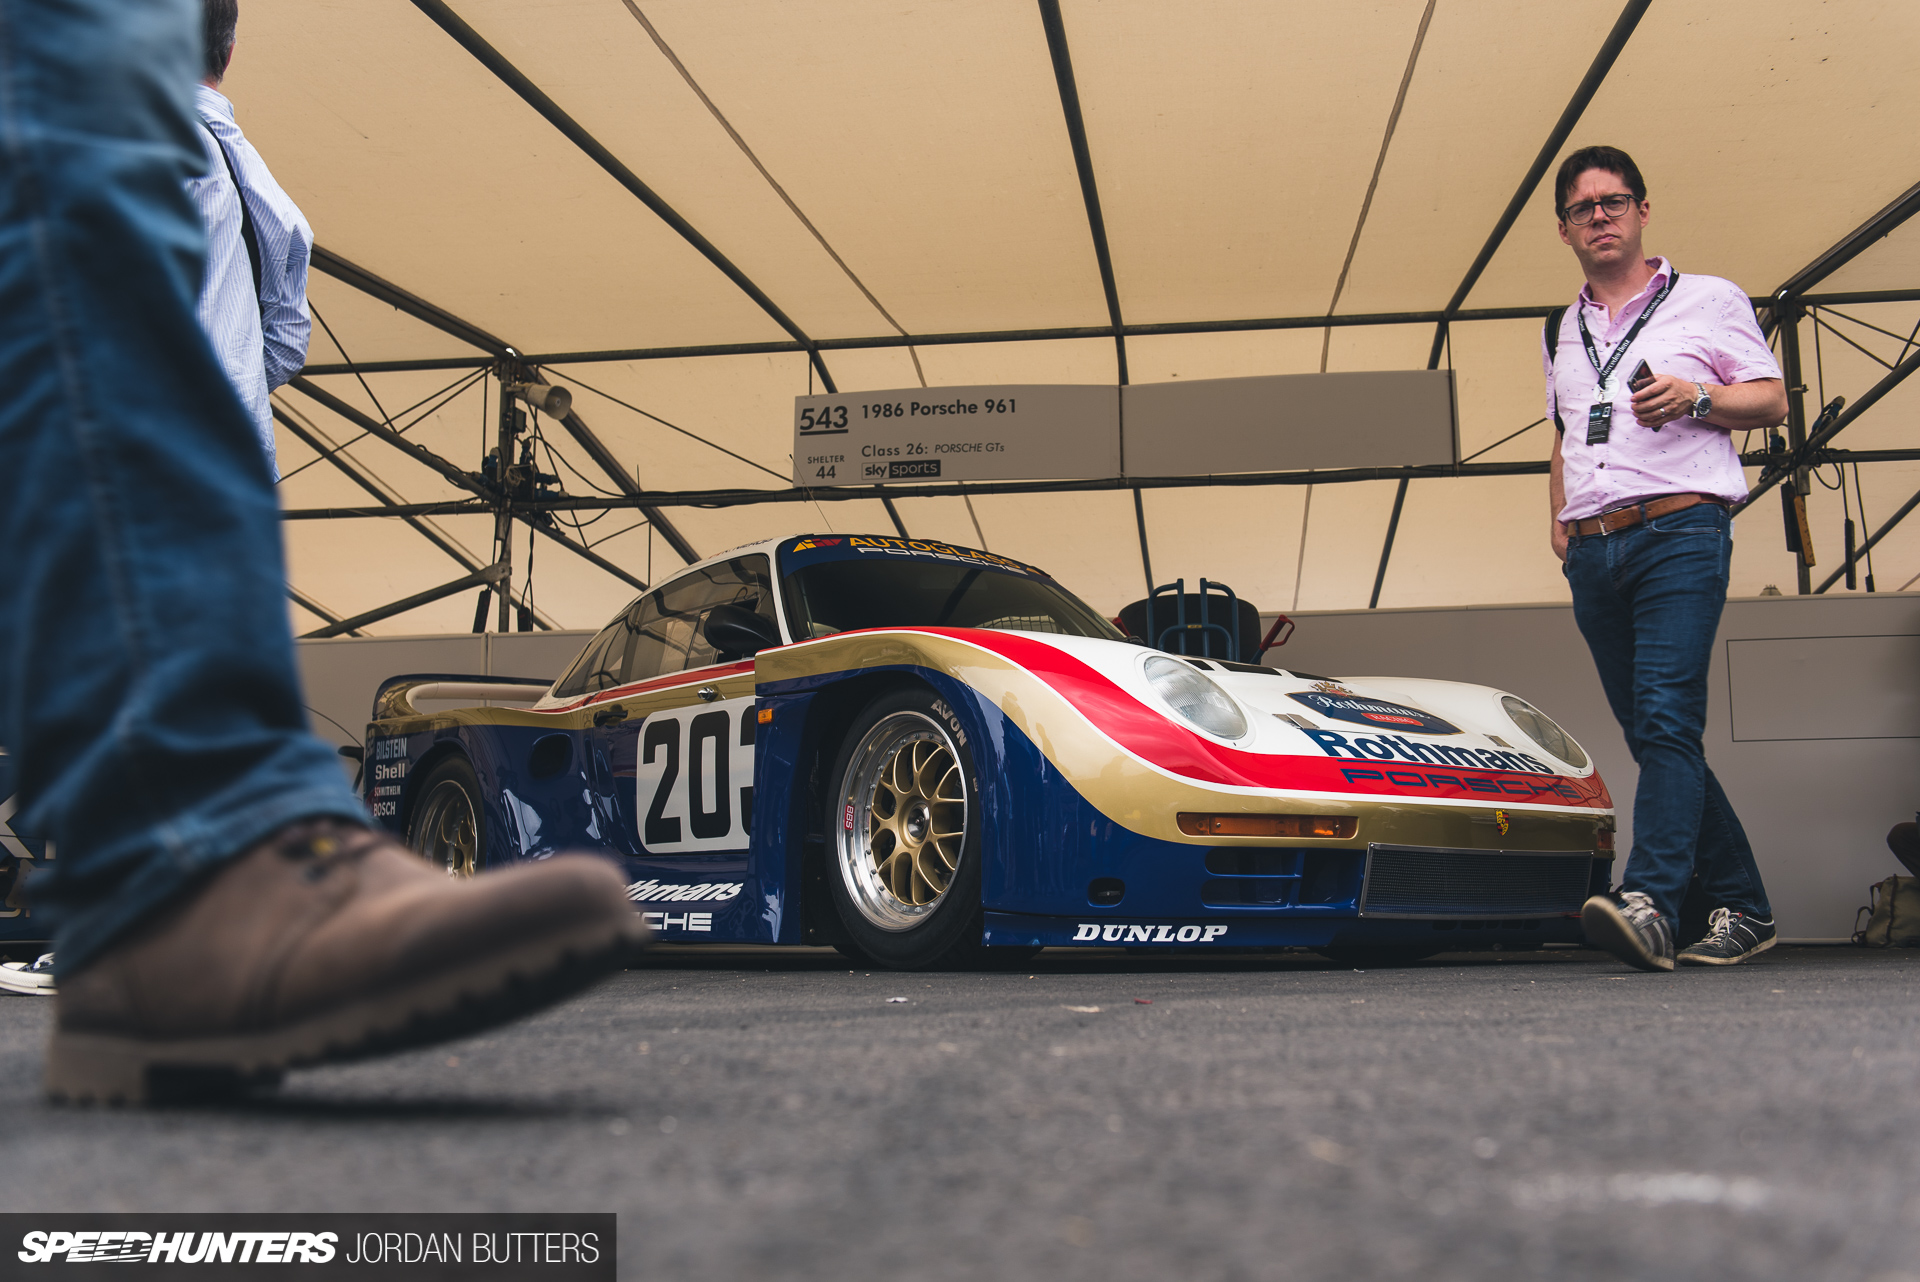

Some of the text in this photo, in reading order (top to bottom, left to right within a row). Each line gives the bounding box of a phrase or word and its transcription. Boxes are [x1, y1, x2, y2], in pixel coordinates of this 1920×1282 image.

[799, 405, 849, 431] 543
[861, 398, 1016, 419] 1986 Porsche 961
[807, 455, 845, 464] SHELTER
[861, 442, 1005, 457] Class 26: PORSCHE GTs
[816, 465, 836, 479] 44
[865, 461, 938, 478] sky sports
[850, 537, 1021, 569] AUTOGLASS
[857, 547, 1028, 575] PORSCHE
[930, 699, 967, 747] AVON
[376, 737, 408, 760] BILSTEIN
[1301, 729, 1554, 775] Rothmans
[375, 763, 405, 780] Shell
[1339, 768, 1582, 799] PORSCHE
[373, 801, 396, 817] BOSCH
[845, 804, 854, 829] BBS
[620, 879, 744, 902] thmans
[1073, 923, 1228, 942] DUNLOP
